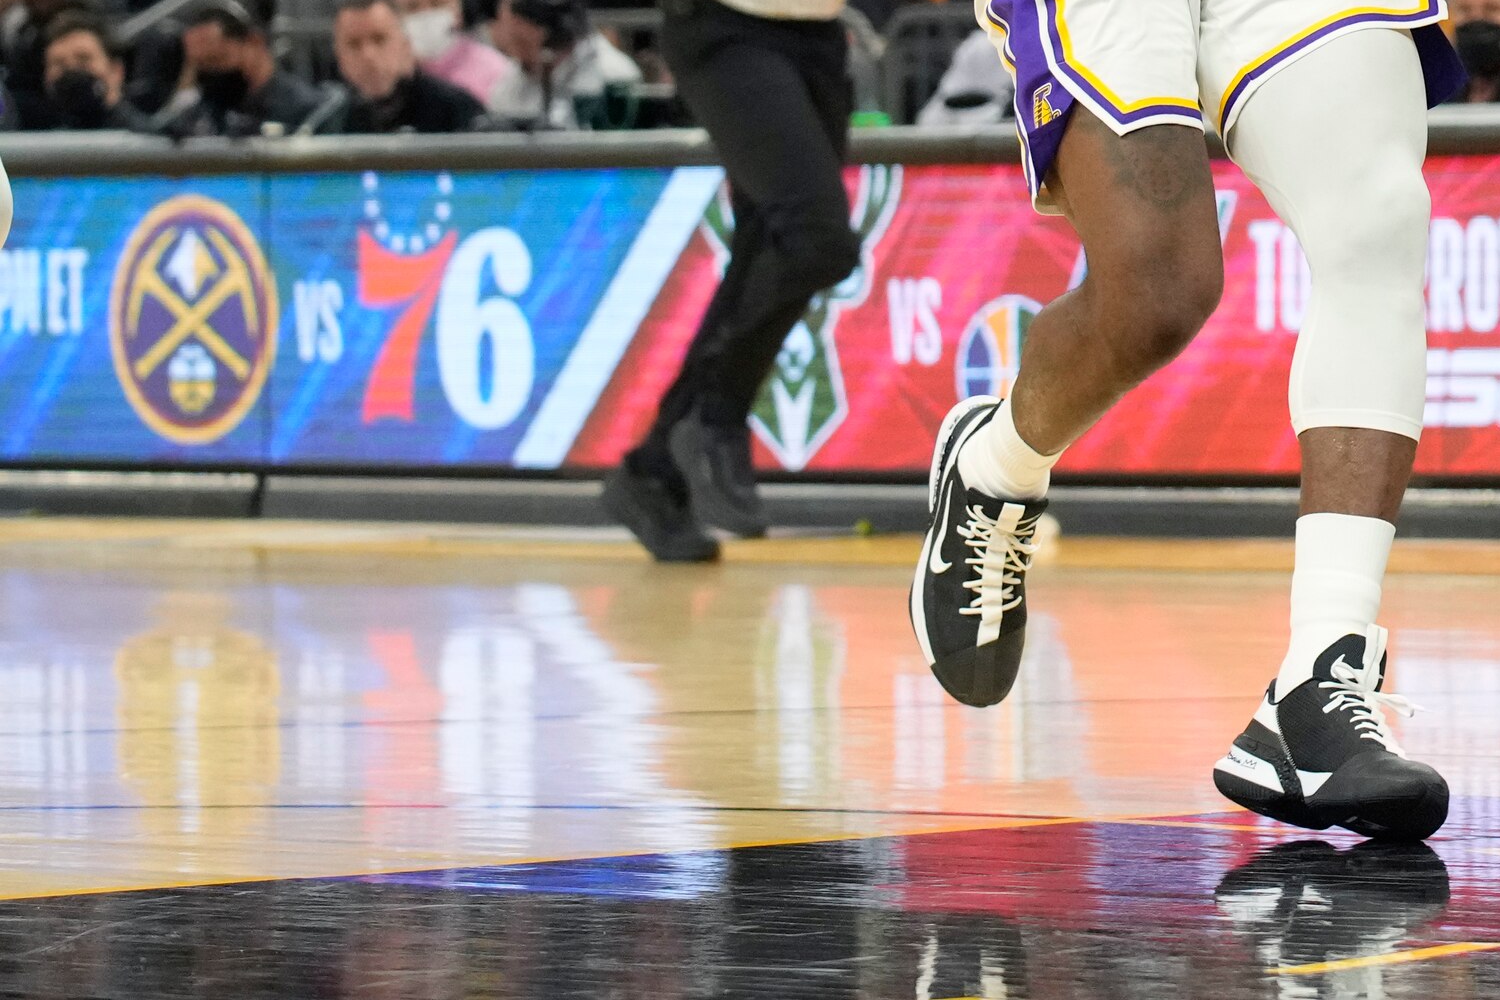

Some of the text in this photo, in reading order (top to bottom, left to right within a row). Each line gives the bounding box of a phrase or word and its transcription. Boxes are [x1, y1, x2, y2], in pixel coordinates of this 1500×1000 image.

[47, 249, 89, 334] ET
[292, 278, 345, 364] VS
[357, 226, 536, 431] 76
[887, 276, 943, 366] VS
